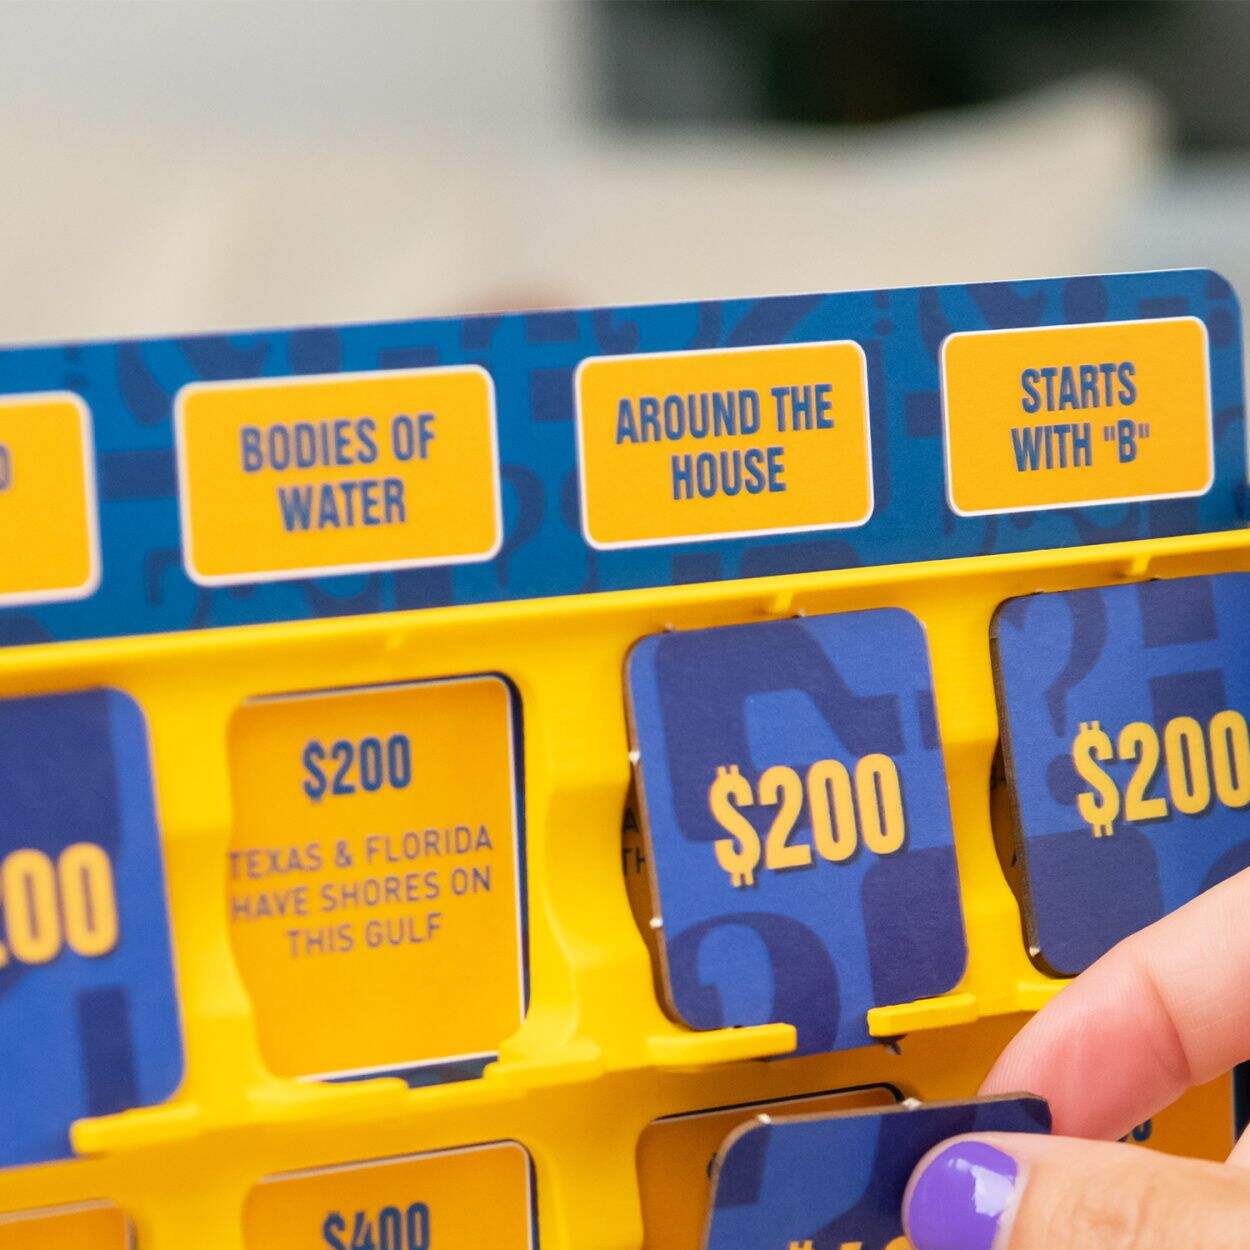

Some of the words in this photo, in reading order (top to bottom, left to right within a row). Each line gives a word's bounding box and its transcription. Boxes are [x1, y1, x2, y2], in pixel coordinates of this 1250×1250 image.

[615, 389, 760, 445] AROUND
[770, 383, 834, 433] THE
[1021, 361, 1137, 414] STARTS
[240, 417, 378, 473] BODIES
[391, 413, 435, 462] OF
[1010, 422, 1092, 473] WITH
[1103, 419, 1149, 464] "B"
[671, 446, 786, 501] HOUSE
[278, 477, 406, 532] WATER
[302, 734, 412, 802] $200
[708, 752, 905, 888] $200
[227, 842, 323, 880] TEXAS
[335, 840, 353, 869] &
[365, 824, 493, 863] FLORIDA
[0, 842, 119, 967] 00
[230, 887, 308, 923] HAVE
[320, 870, 441, 913] SHORES
[451, 865, 491, 896] ON
[285, 924, 355, 958] THIS
[364, 911, 443, 949] GULF
